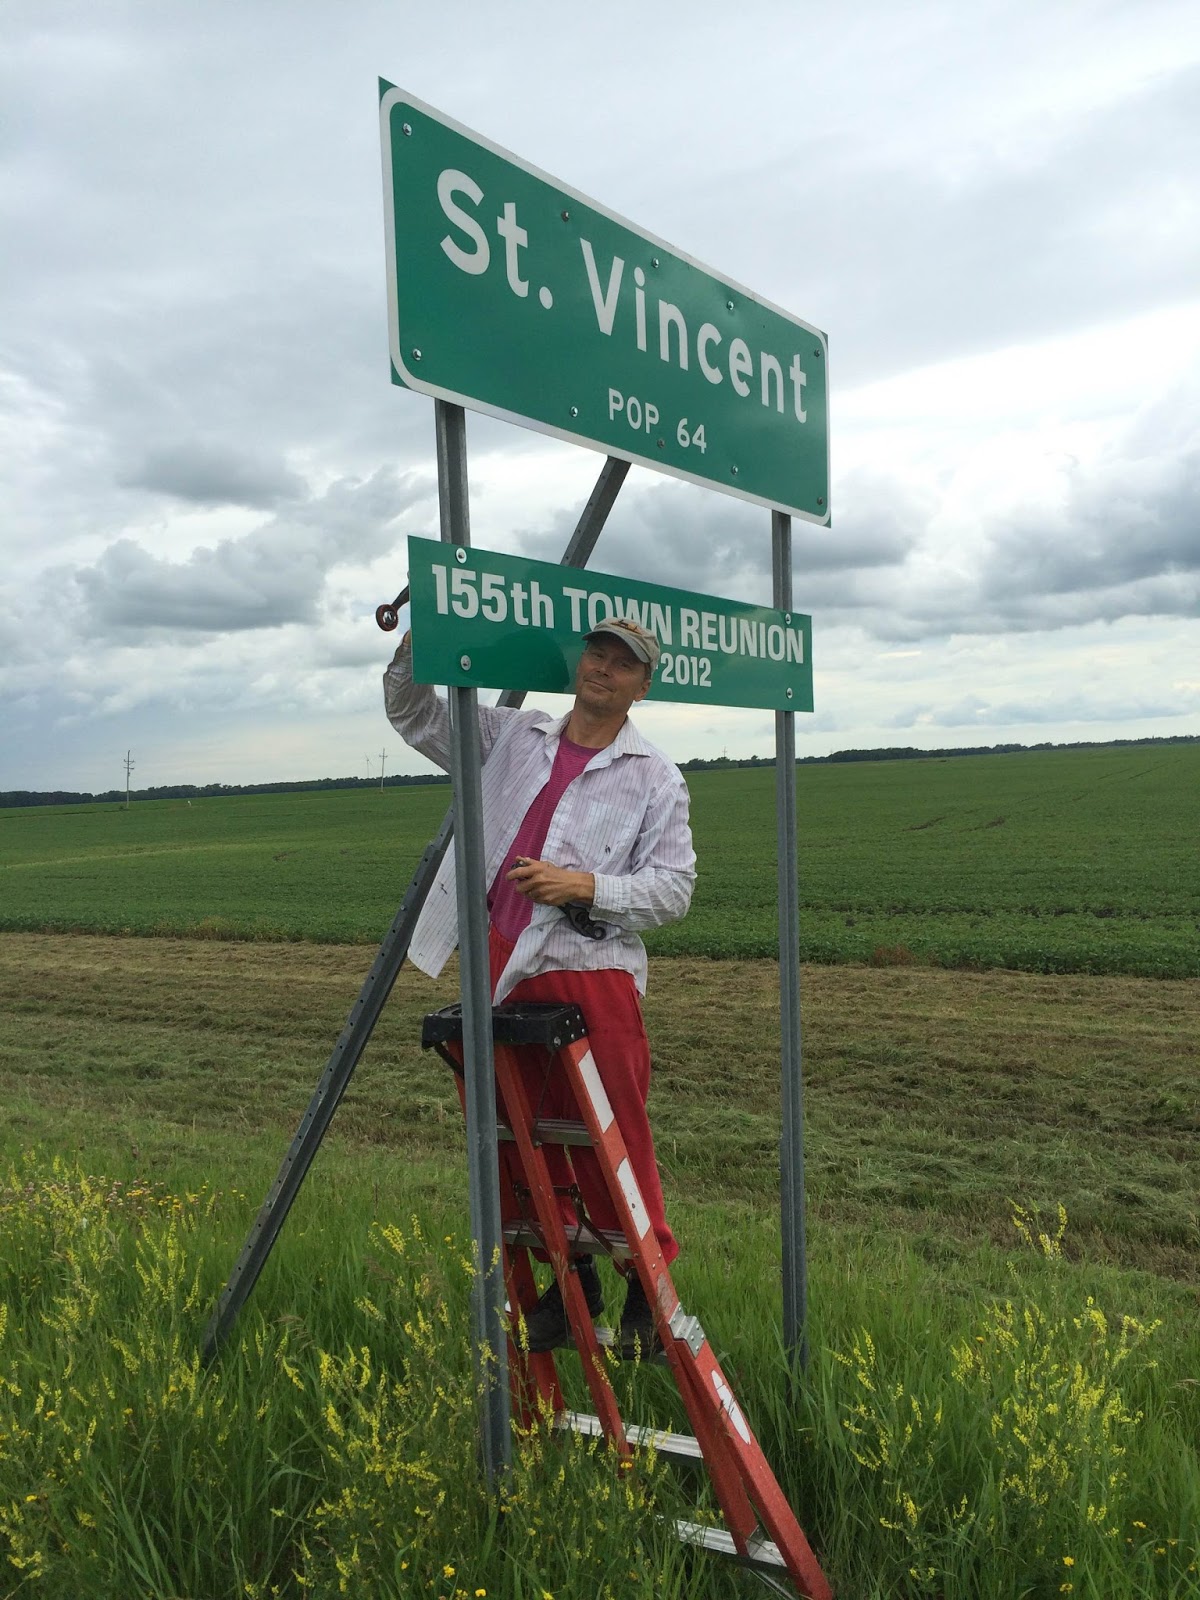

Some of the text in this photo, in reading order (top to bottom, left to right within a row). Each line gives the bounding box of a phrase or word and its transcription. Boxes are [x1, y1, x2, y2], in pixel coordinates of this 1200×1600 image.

[437, 169, 807, 424] St. Vincent
[608, 388, 707, 454] POP 64
[431, 564, 554, 629] 155th
[680, 607, 804, 664] REUNION
